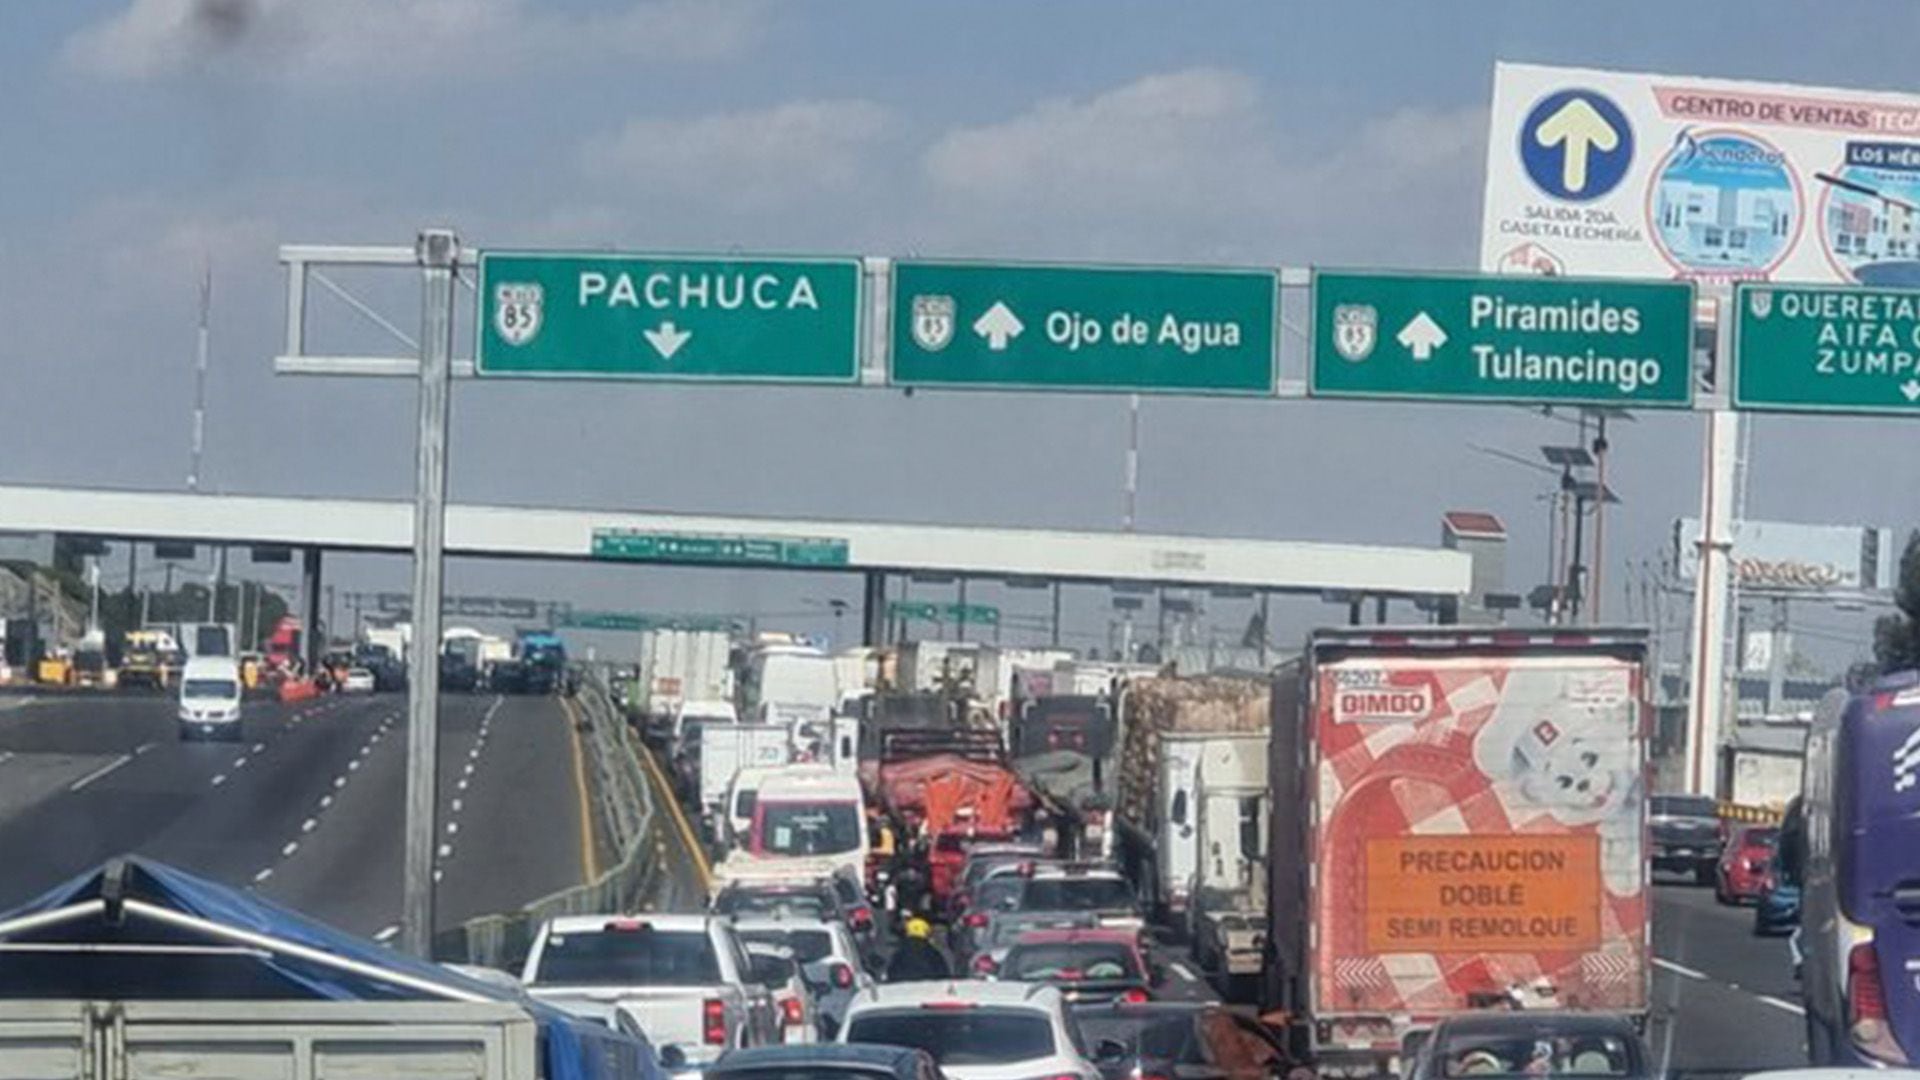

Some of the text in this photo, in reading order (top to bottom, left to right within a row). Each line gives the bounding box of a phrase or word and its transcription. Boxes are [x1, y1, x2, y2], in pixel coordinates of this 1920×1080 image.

[1672, 95, 1754, 119] CENTRO
[1759, 102, 1785, 121] DE
[1790, 107, 1869, 127] VENTAS
[1852, 147, 1884, 164] LOS
[1525, 205, 1581, 221] SALIDA
[1500, 220, 1561, 236] CASETA
[579, 272, 818, 310] PACHUCA
[504, 305, 532, 328] 85
[1470, 296, 1640, 333] Piramides
[1045, 311, 1241, 352] Ojo de Agua
[1818, 322, 1898, 348] AIFA
[1472, 345, 1661, 392] Tulancingo
[1341, 694, 1425, 713] BIMBO
[1400, 850, 1565, 873] PRECAUCION
[1439, 885, 1525, 907] DOBLE
[1387, 917, 1578, 939] SEMI REMOLQUE
